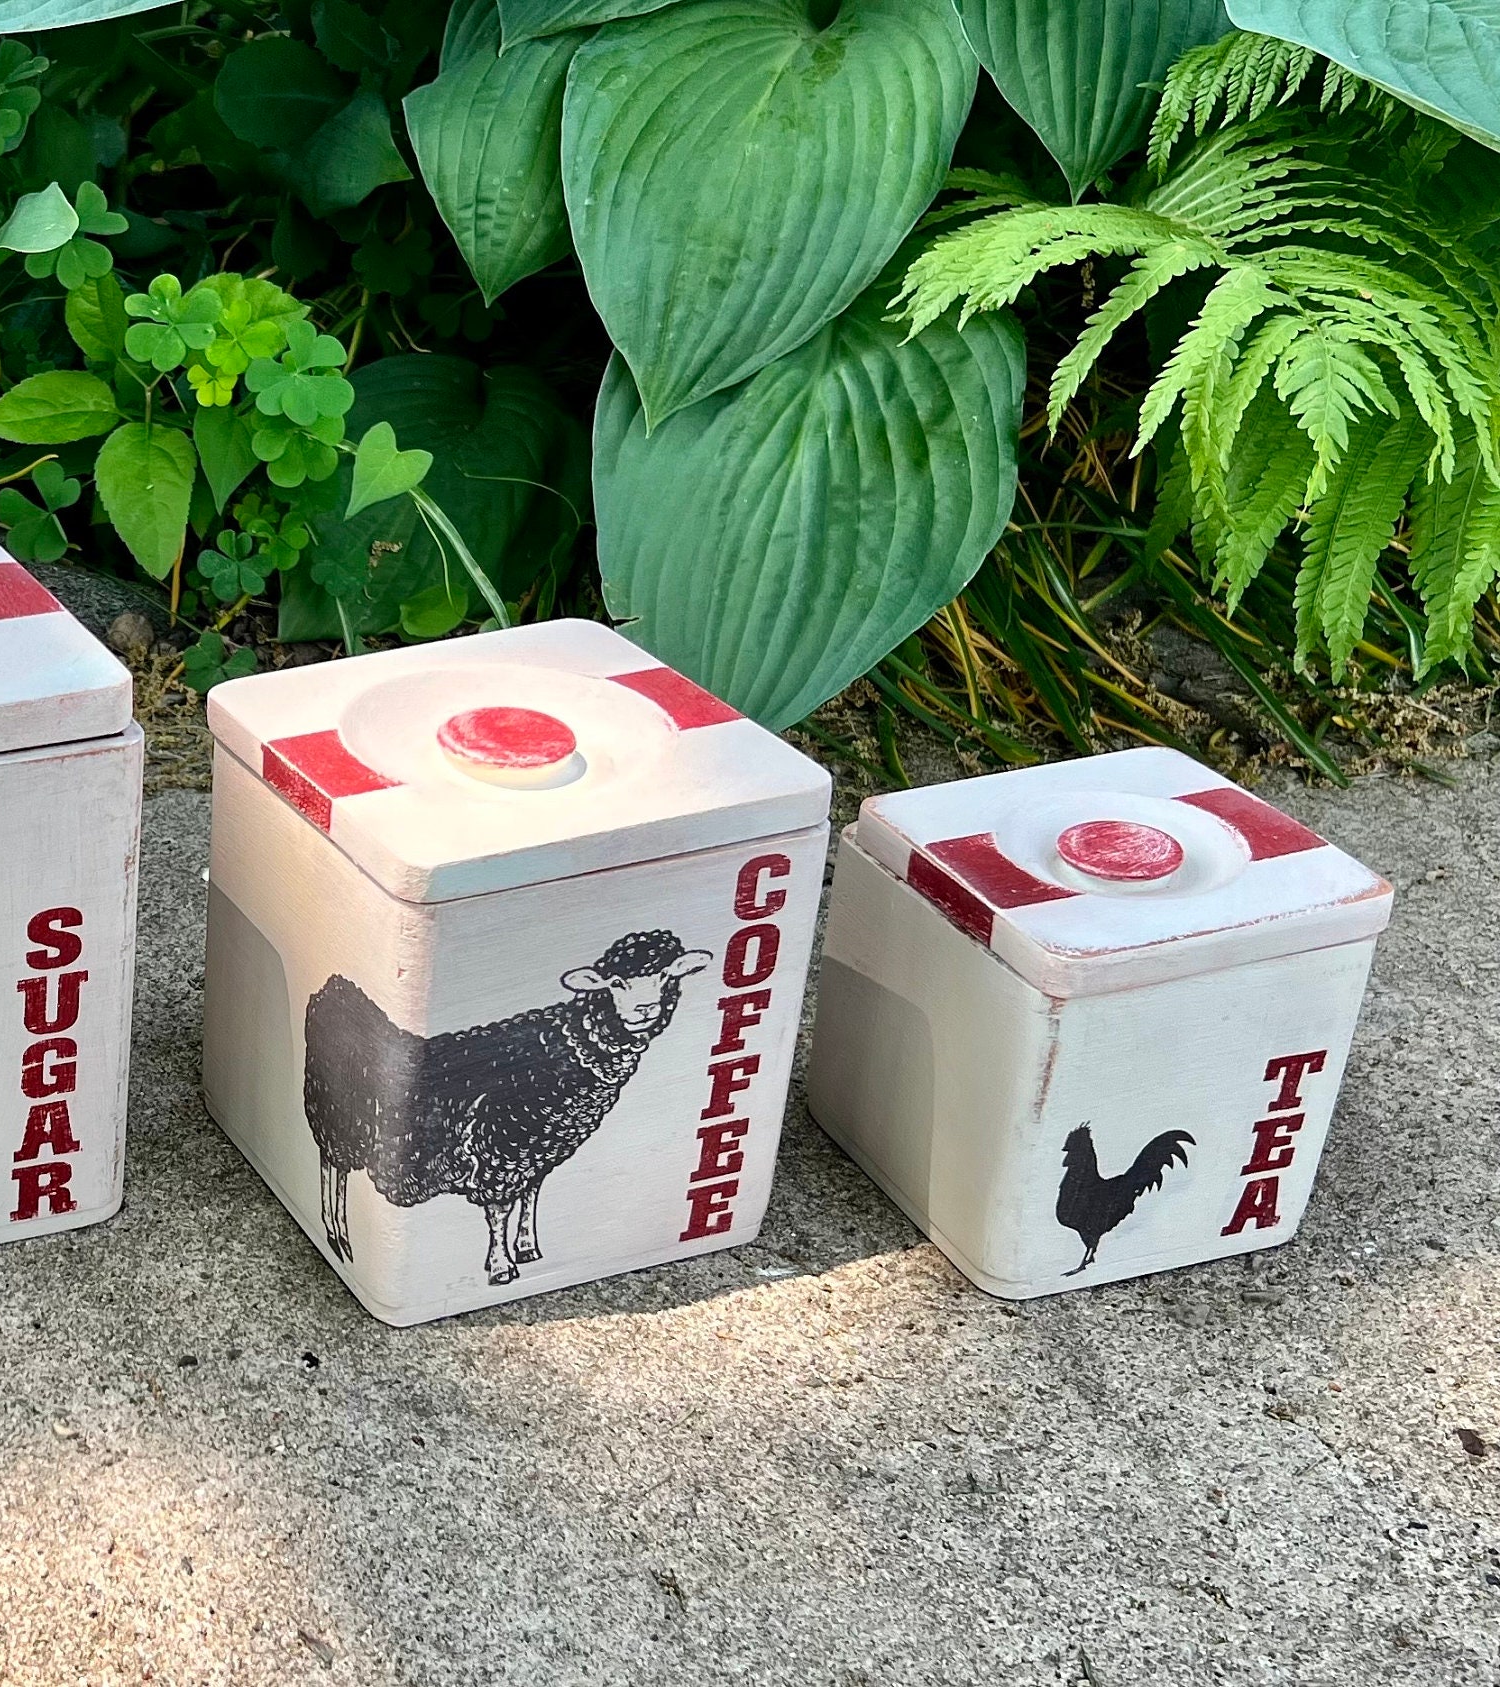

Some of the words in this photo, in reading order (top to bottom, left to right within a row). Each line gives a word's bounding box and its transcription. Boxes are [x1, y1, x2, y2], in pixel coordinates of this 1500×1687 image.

[9, 907, 89, 1221] SUGAR
[679, 854, 791, 1242] COFFEE
[1221, 1050, 1327, 1236] TEA
